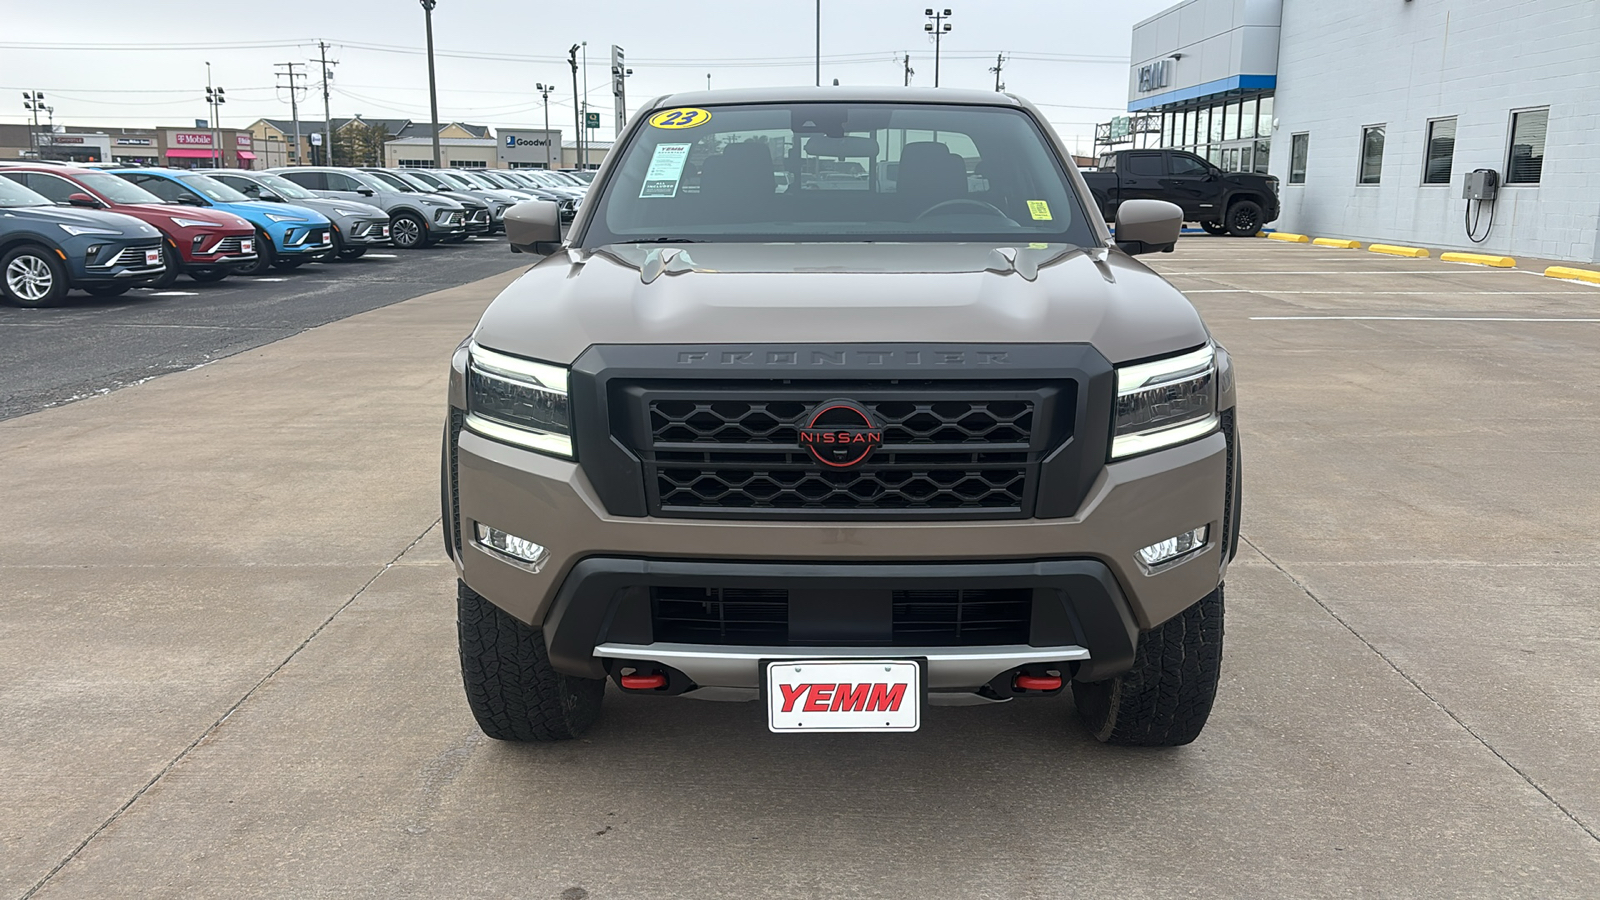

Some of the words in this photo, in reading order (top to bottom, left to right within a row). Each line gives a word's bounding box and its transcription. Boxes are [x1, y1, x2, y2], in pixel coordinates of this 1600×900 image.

[659, 110, 699, 126] 23
[185, 135, 211, 144] Mobile
[516, 138, 552, 147] Goodwl
[676, 350, 1012, 366] FRONTIER
[800, 431, 881, 444] NISSAN
[778, 682, 909, 713] YEMM
